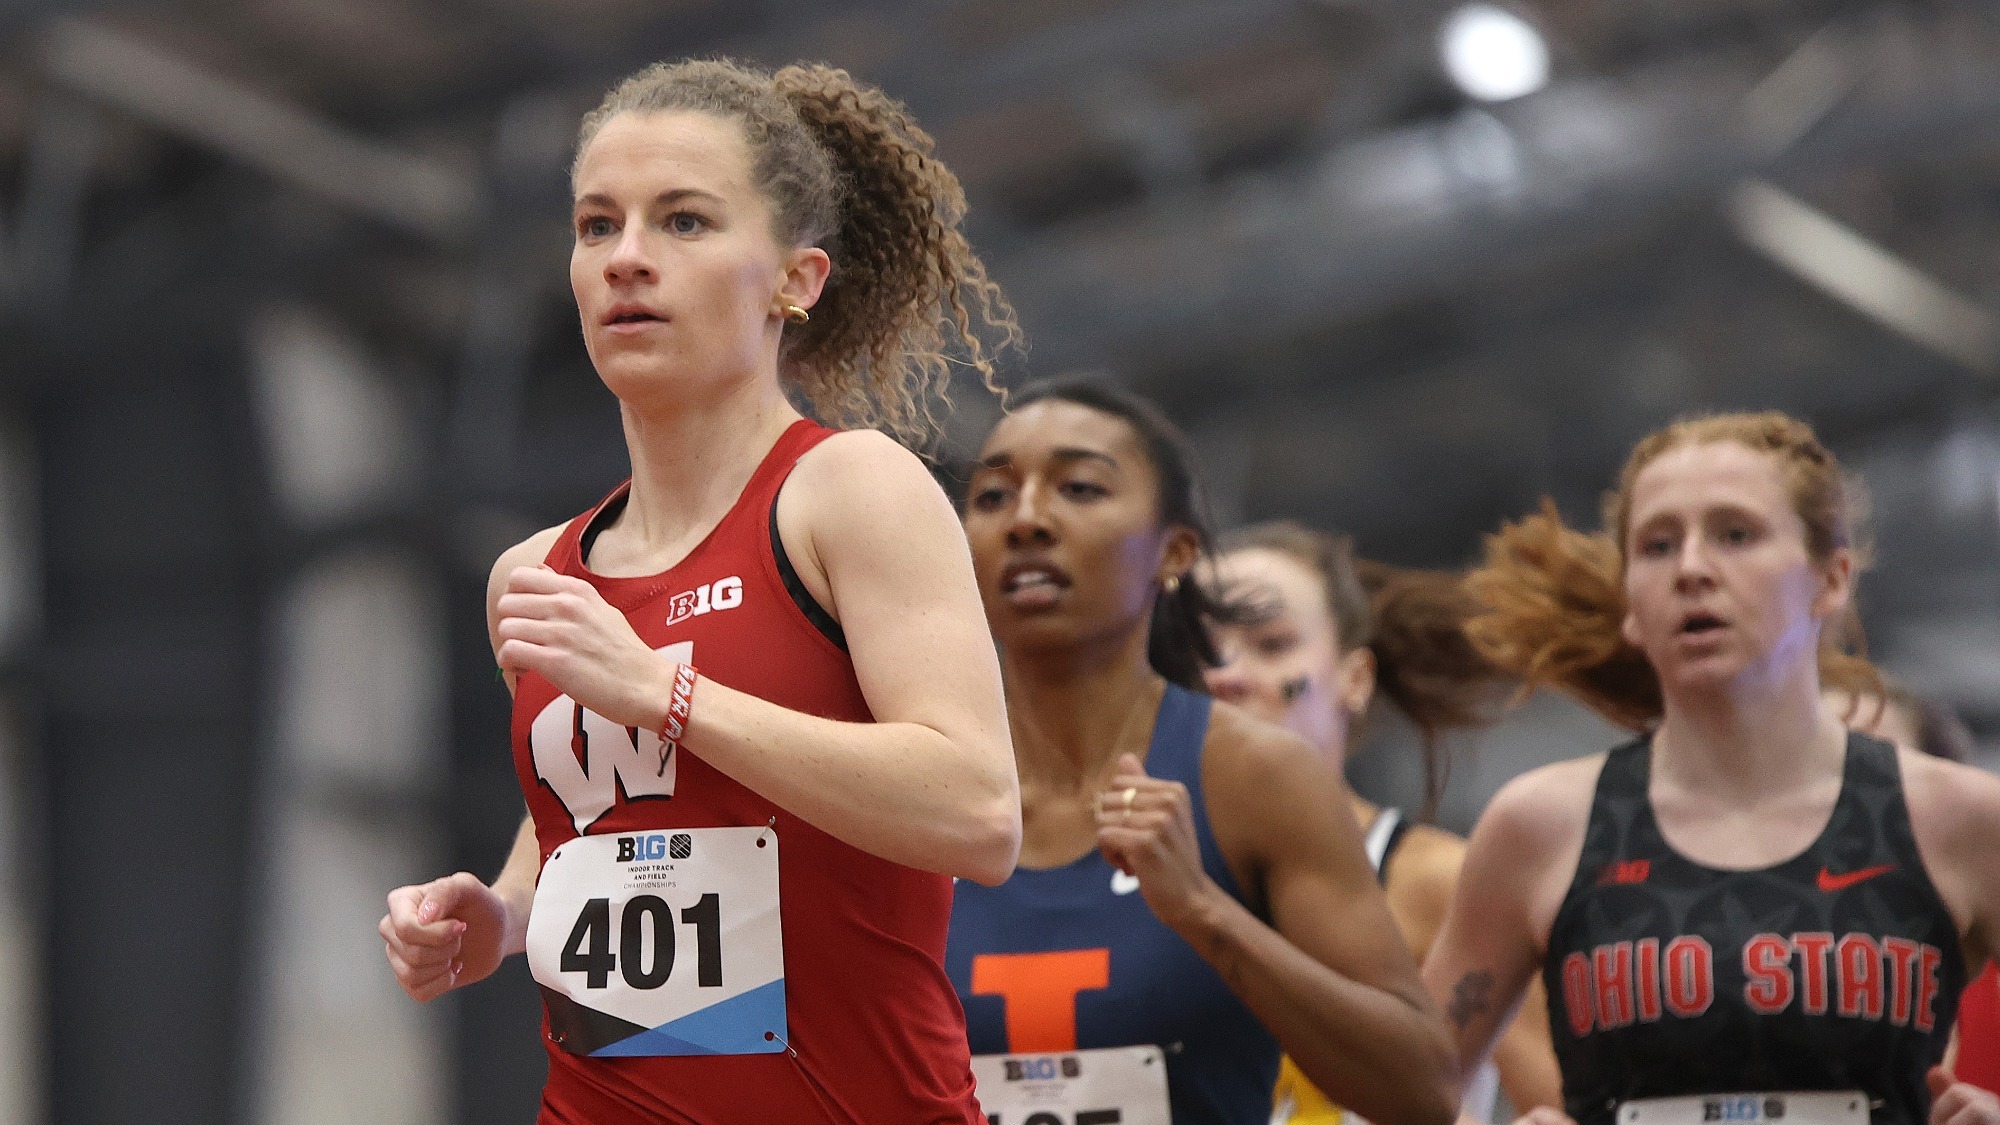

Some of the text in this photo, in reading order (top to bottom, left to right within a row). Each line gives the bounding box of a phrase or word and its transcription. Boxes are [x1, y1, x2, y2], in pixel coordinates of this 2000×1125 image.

[623, 881, 677, 889] CHAMPIONSHIPS
[627, 864, 675, 873] INDOOR TRACK
[560, 893, 723, 990] 401
[1561, 931, 1942, 1037] OHIO STATE
